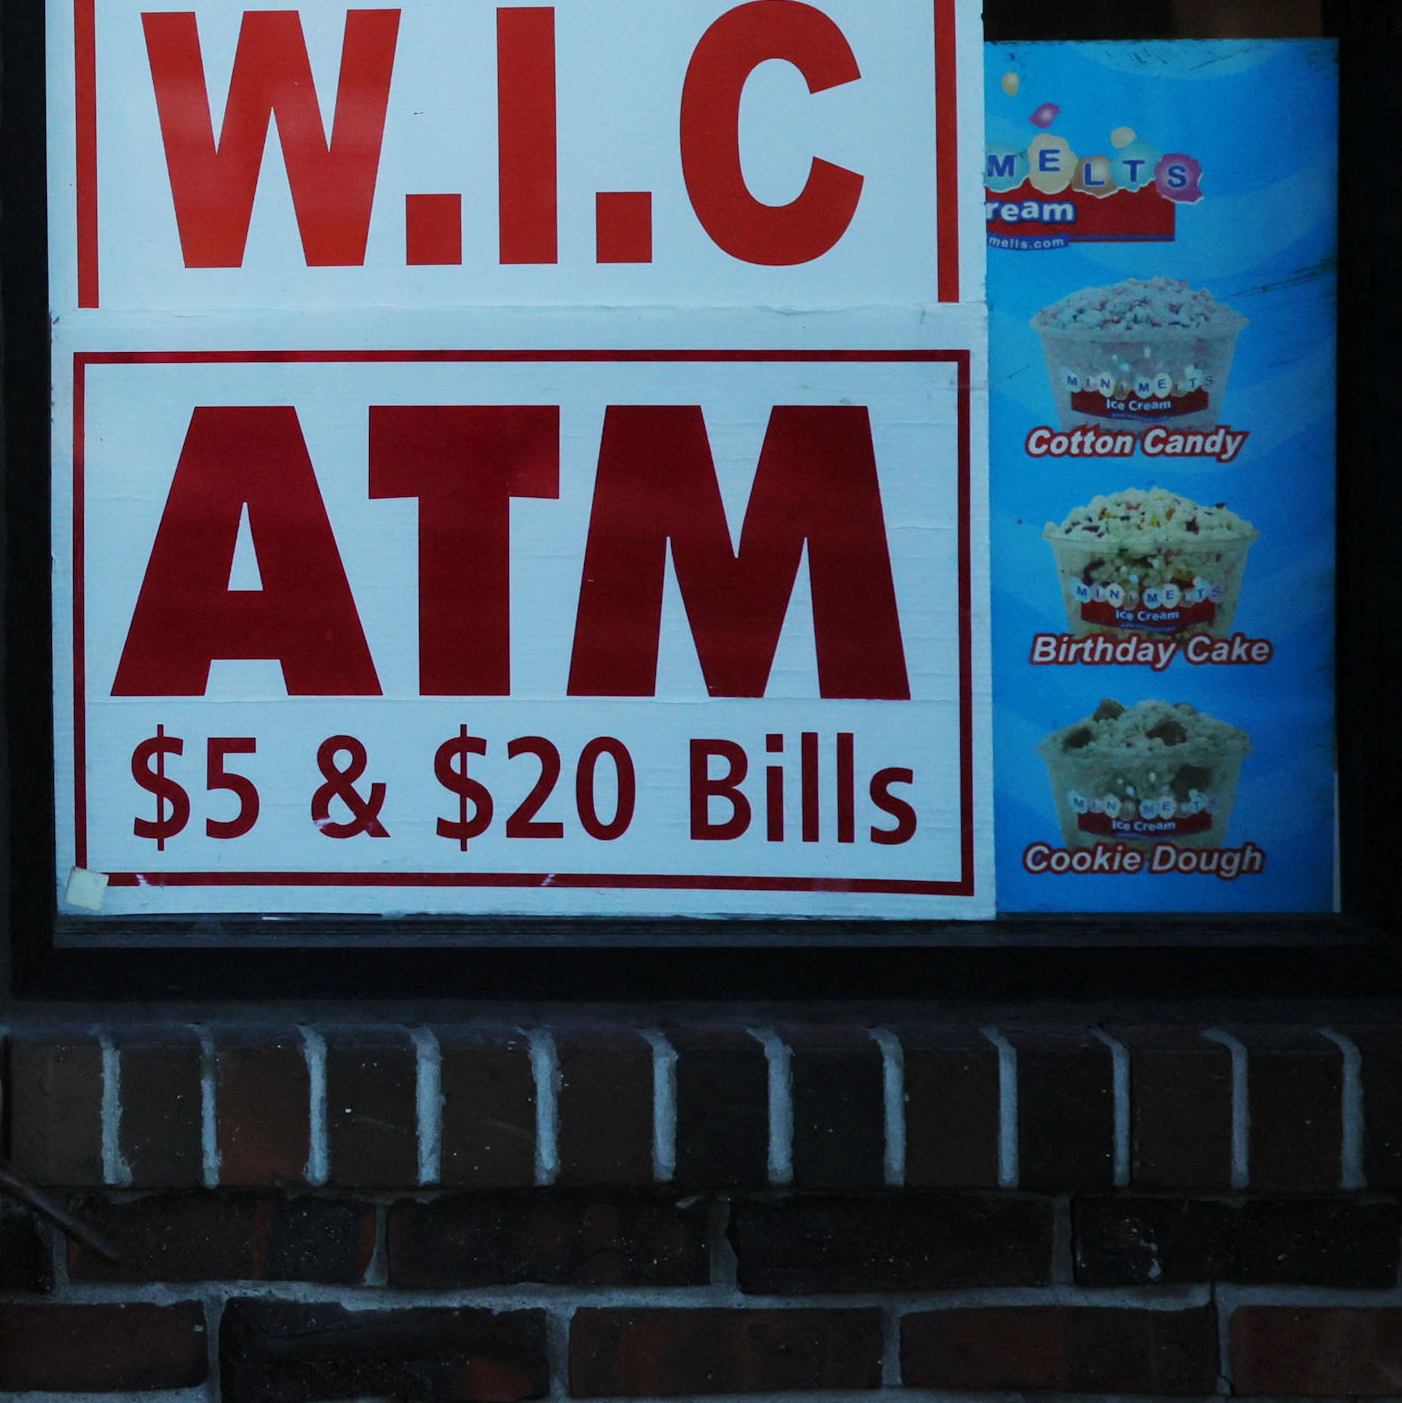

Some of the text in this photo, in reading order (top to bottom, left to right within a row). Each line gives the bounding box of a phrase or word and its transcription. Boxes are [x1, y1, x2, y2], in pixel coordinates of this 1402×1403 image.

[140, 0, 865, 269] W.I.C
[986, 148, 1188, 188] MELTS
[1106, 398, 1172, 411] Ice Cream
[1027, 427, 1244, 461] Cotton Candy
[110, 405, 911, 701] ATM
[1115, 609, 1181, 621] Ice Cream
[1032, 635, 1271, 669] Birthday Cake
[130, 723, 918, 852] $5 & $20 Bills
[1112, 819, 1177, 831] Ice Cream
[1025, 845, 1264, 878] Cookie Dough
